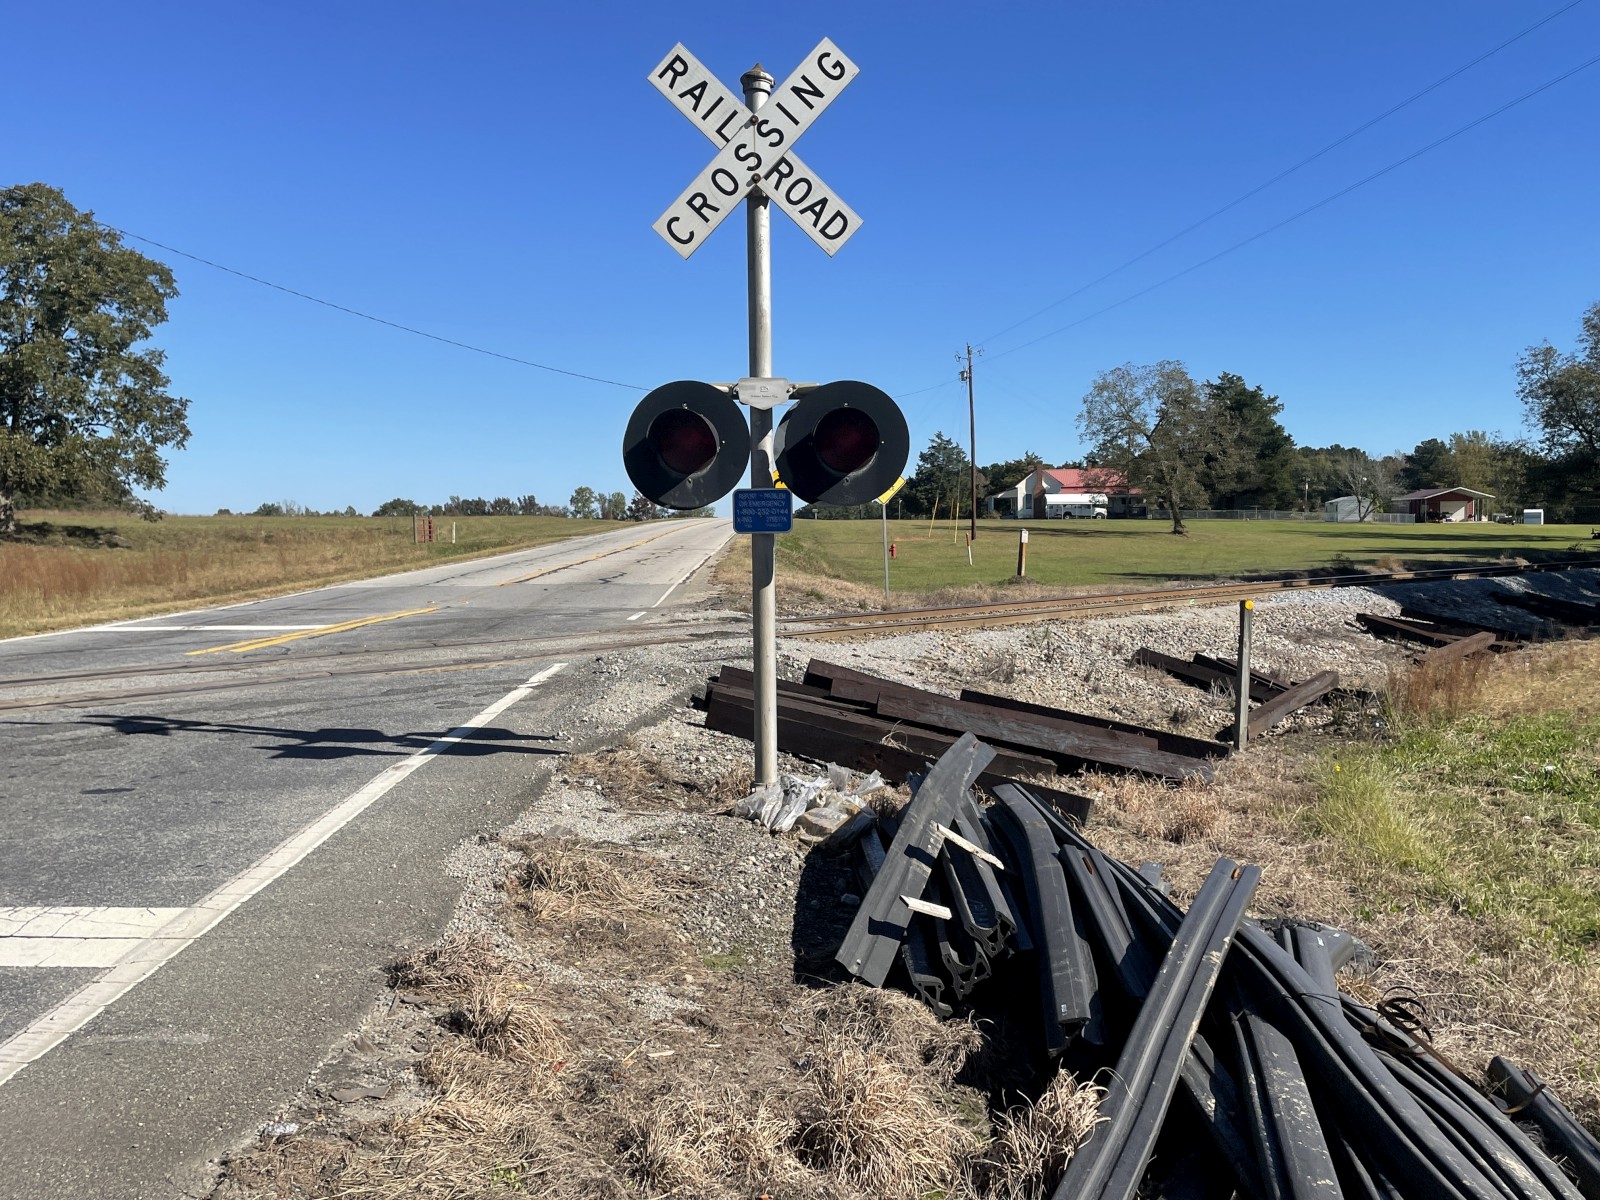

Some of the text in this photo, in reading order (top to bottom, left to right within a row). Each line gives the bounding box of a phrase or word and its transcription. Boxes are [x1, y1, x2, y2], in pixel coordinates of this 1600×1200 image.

[658, 54, 848, 240] RAIL ROAD
[666, 52, 846, 245] CROSSING
